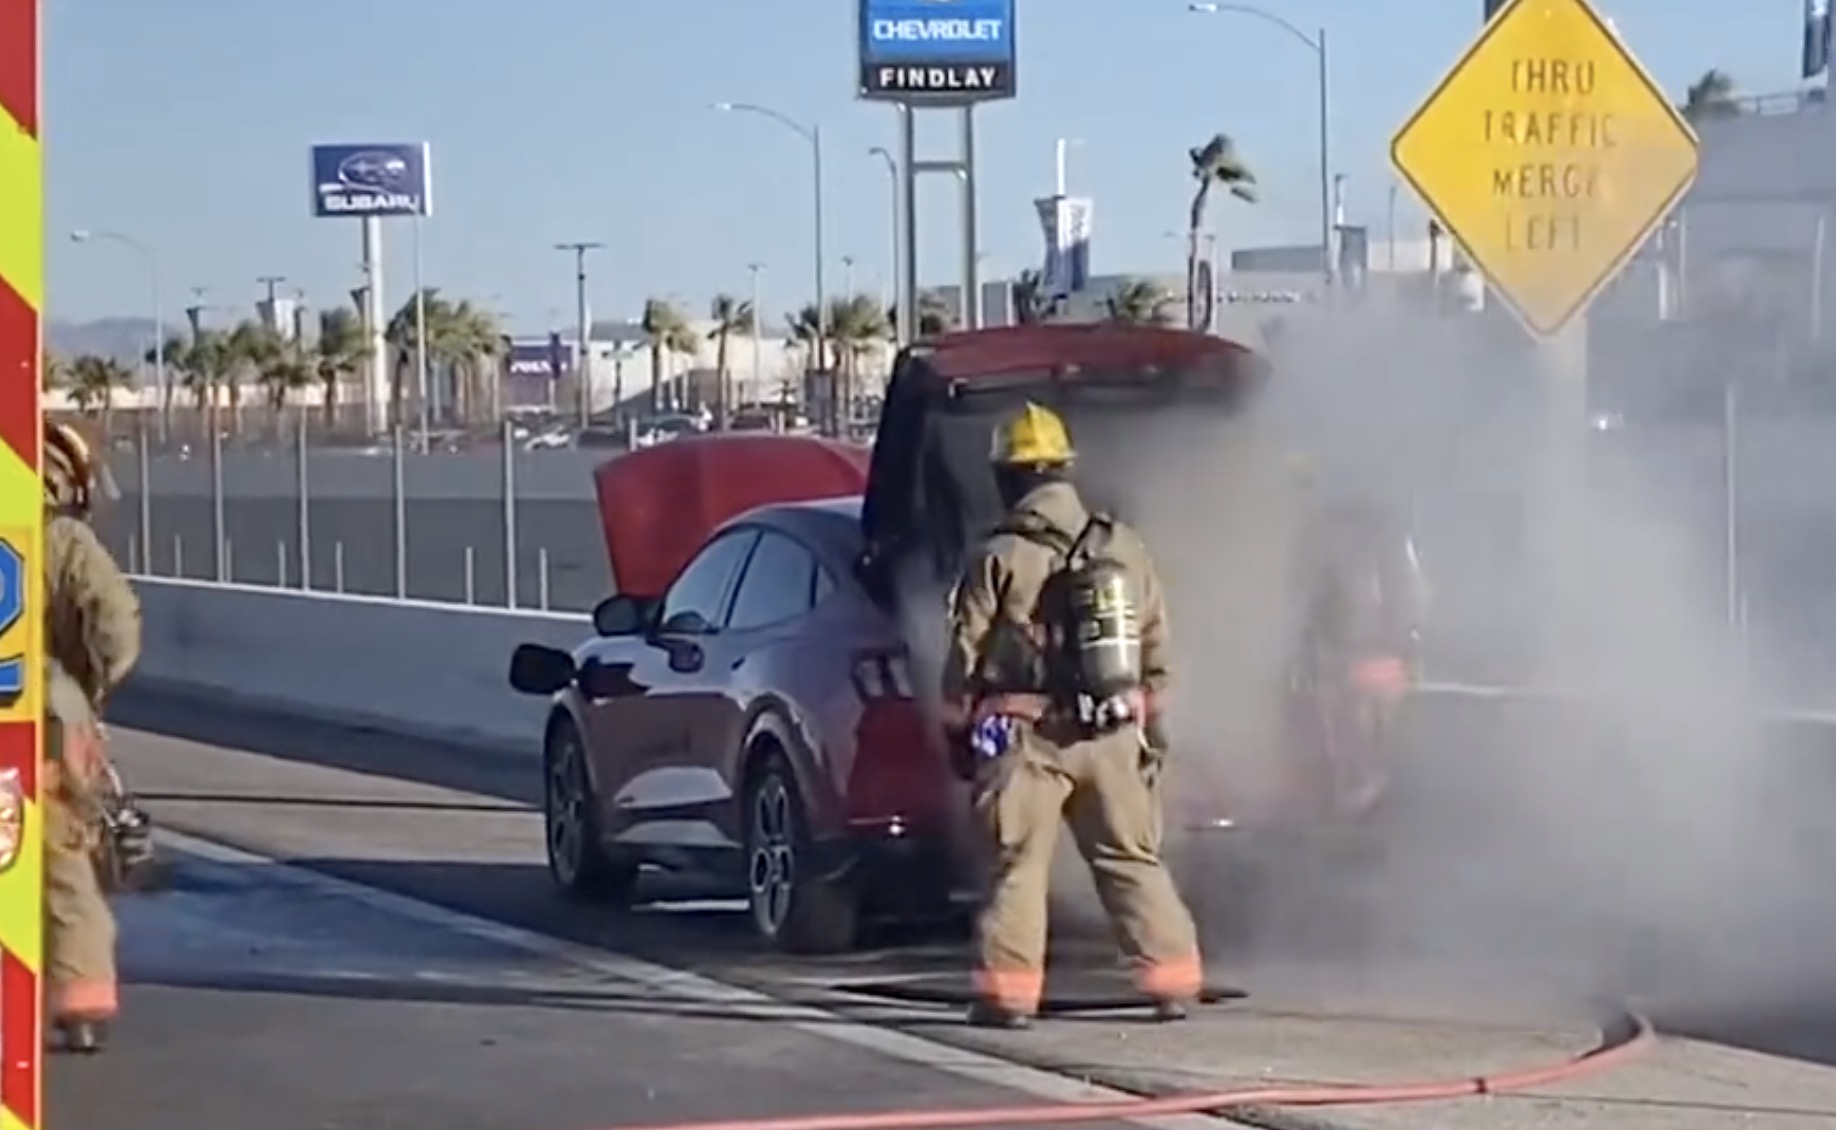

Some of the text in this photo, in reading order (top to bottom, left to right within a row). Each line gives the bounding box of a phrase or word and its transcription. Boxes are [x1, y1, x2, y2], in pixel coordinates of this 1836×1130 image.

[873, 19, 1002, 40] CHEVROLET
[880, 67, 996, 87] FINDLAY
[1511, 58, 1595, 95] THRU
[1484, 110, 1617, 147] TRAFFIC
